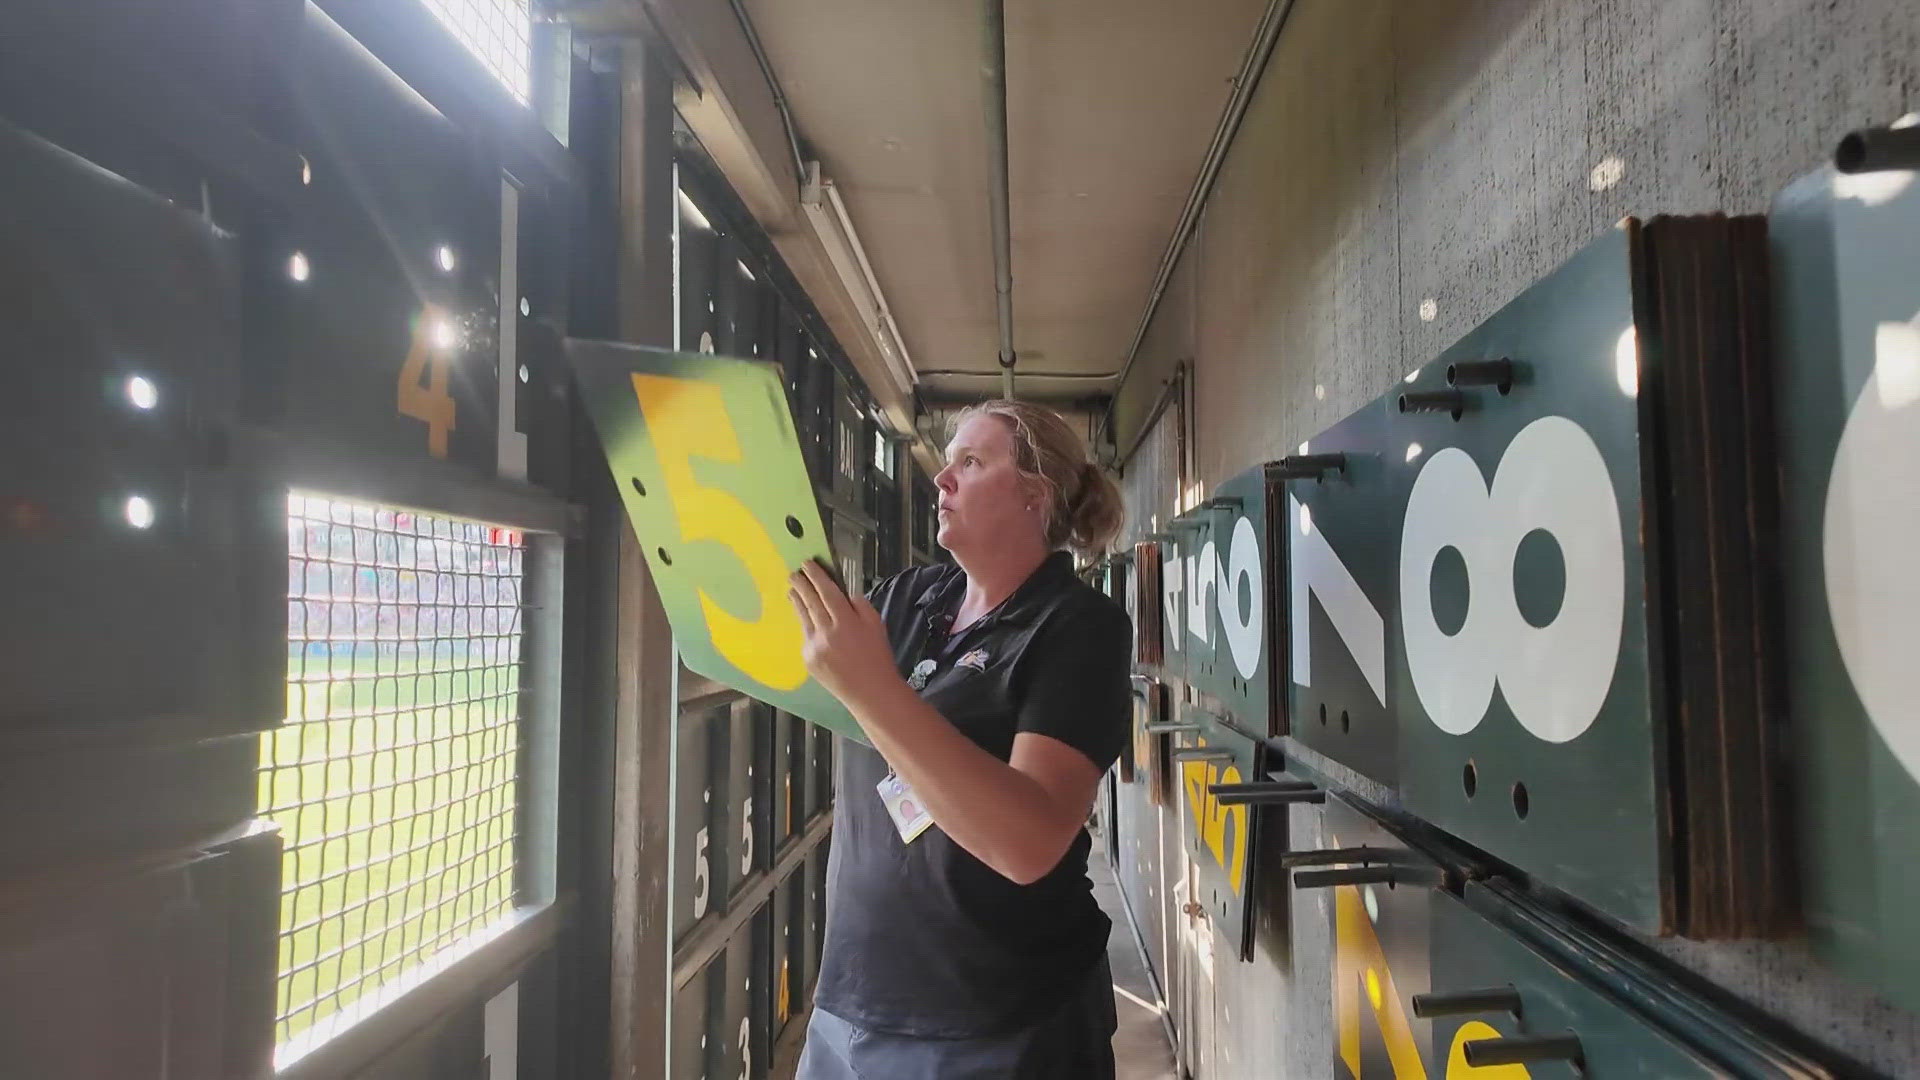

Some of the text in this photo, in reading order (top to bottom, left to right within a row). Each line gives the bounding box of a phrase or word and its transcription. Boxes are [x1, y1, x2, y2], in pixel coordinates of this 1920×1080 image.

[398, 300, 456, 459] 4
[631, 373, 808, 691] 5
[1187, 541, 1216, 651] 5
[1290, 492, 1386, 709] 7
[1401, 415, 1625, 743] 8
[695, 826, 709, 919] 5
[741, 797, 753, 875] 5
